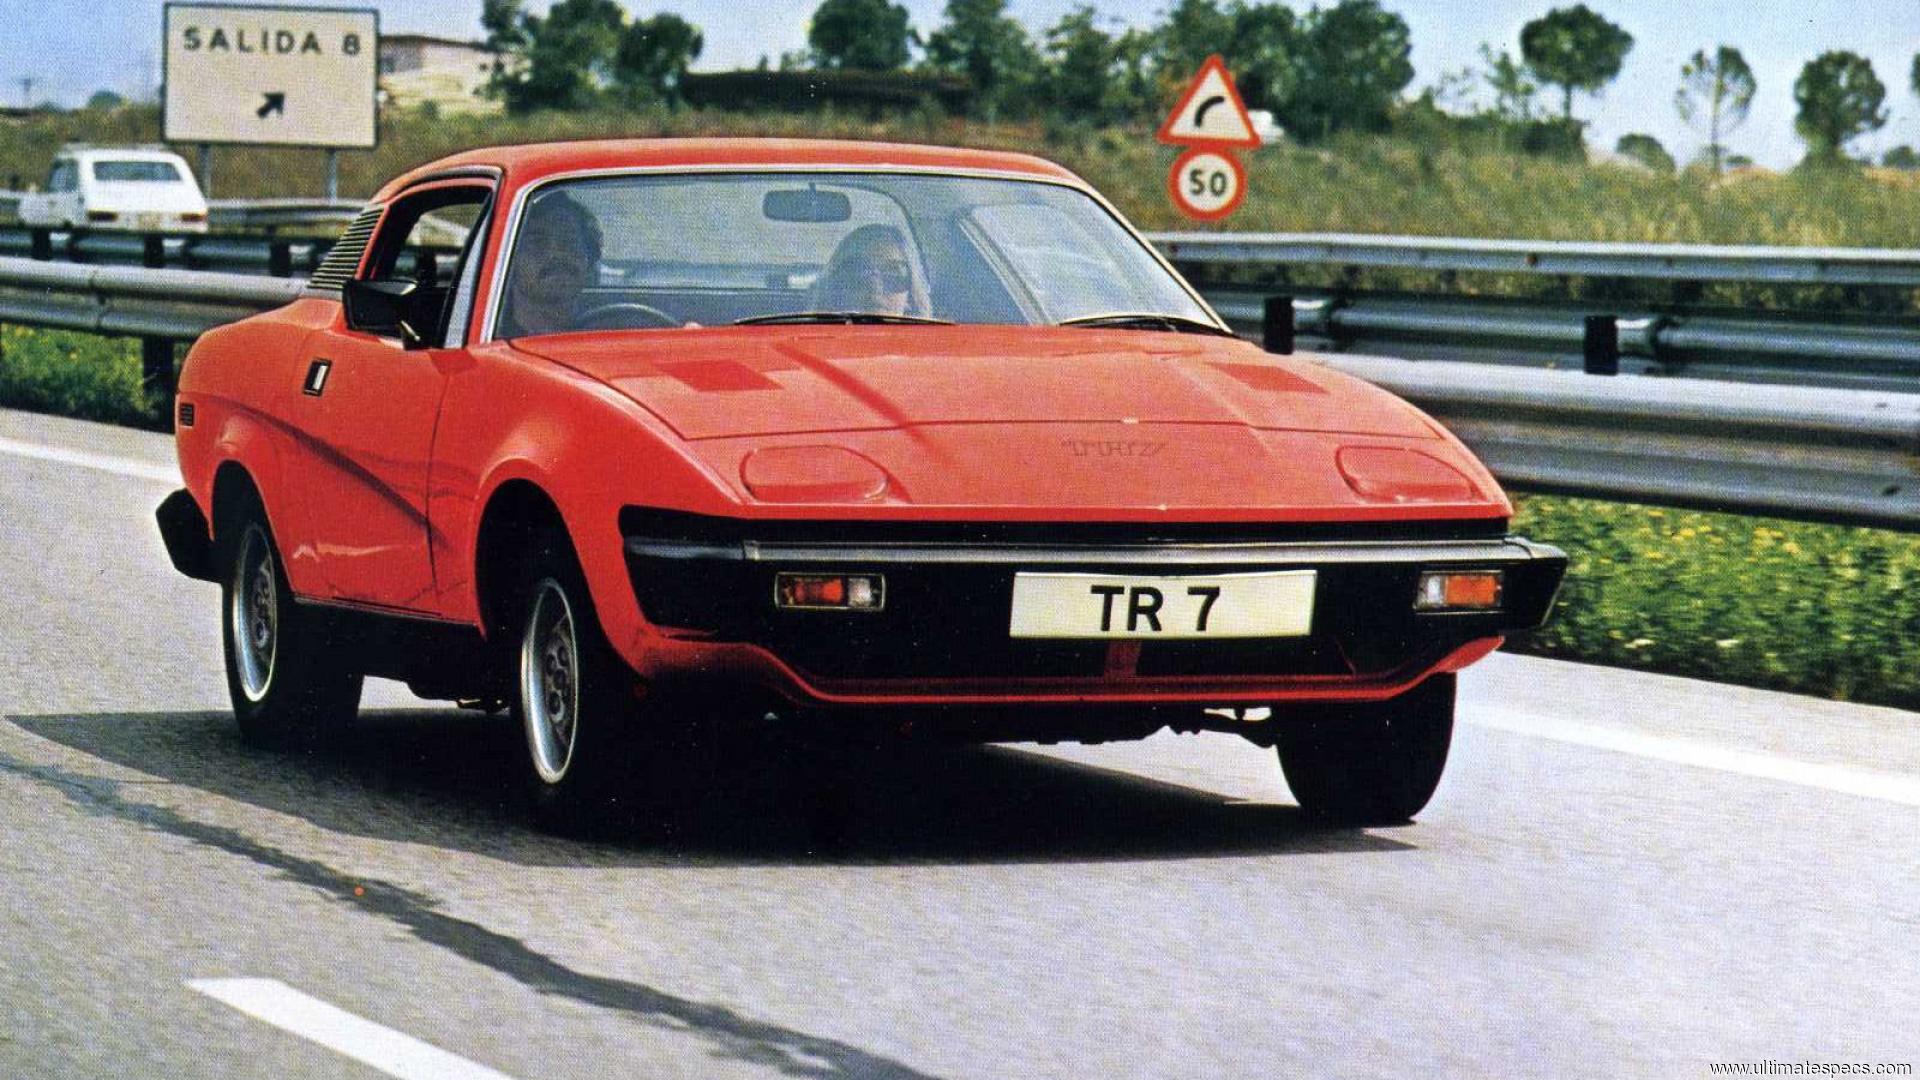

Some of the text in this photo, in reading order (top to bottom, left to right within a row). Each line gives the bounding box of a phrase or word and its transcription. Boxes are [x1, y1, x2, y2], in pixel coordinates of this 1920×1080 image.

[183, 26, 322, 54] SALIDA
[1189, 168, 1227, 197] 50
[1090, 585, 1221, 632] TR 7
